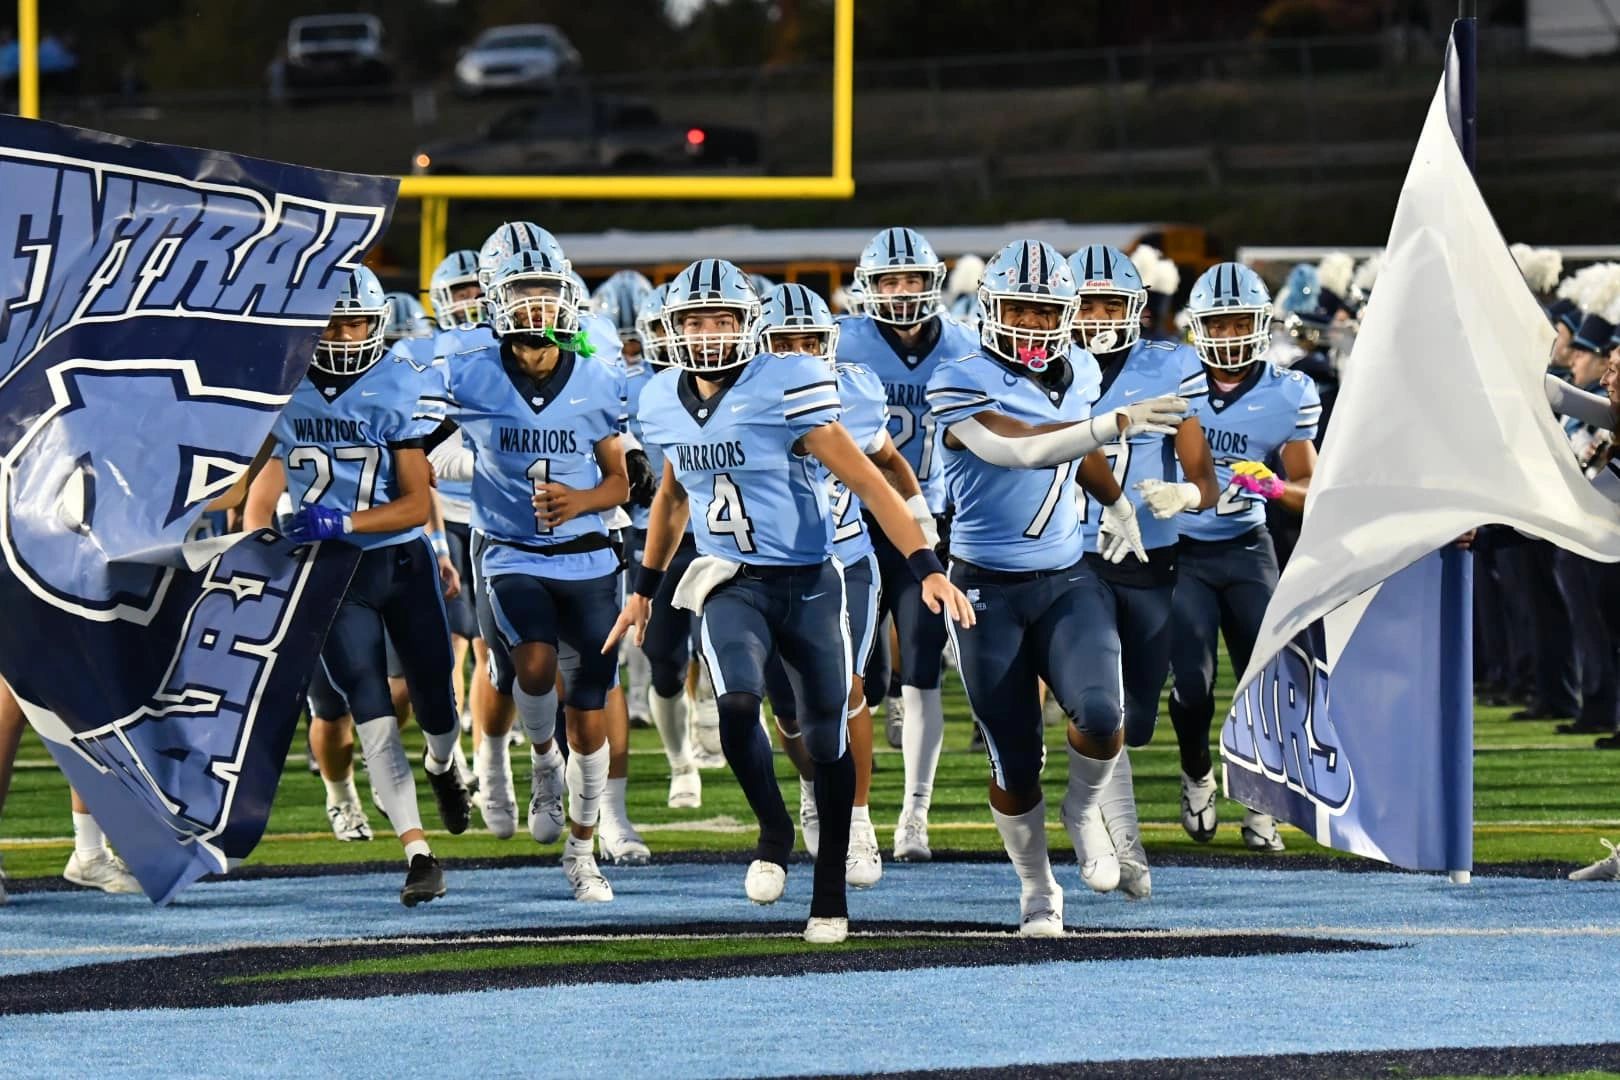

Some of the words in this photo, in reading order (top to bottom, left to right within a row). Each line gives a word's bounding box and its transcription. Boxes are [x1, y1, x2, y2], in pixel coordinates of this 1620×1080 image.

[294, 418, 367, 443] WARRIORS
[500, 426, 577, 454] WARRIORS
[1200, 425, 1249, 455] RIORS
[287, 445, 382, 513] 27
[676, 440, 746, 472] WARRIORS
[525, 457, 554, 536] 1
[706, 472, 758, 554] 4
[1022, 459, 1072, 540] 7
